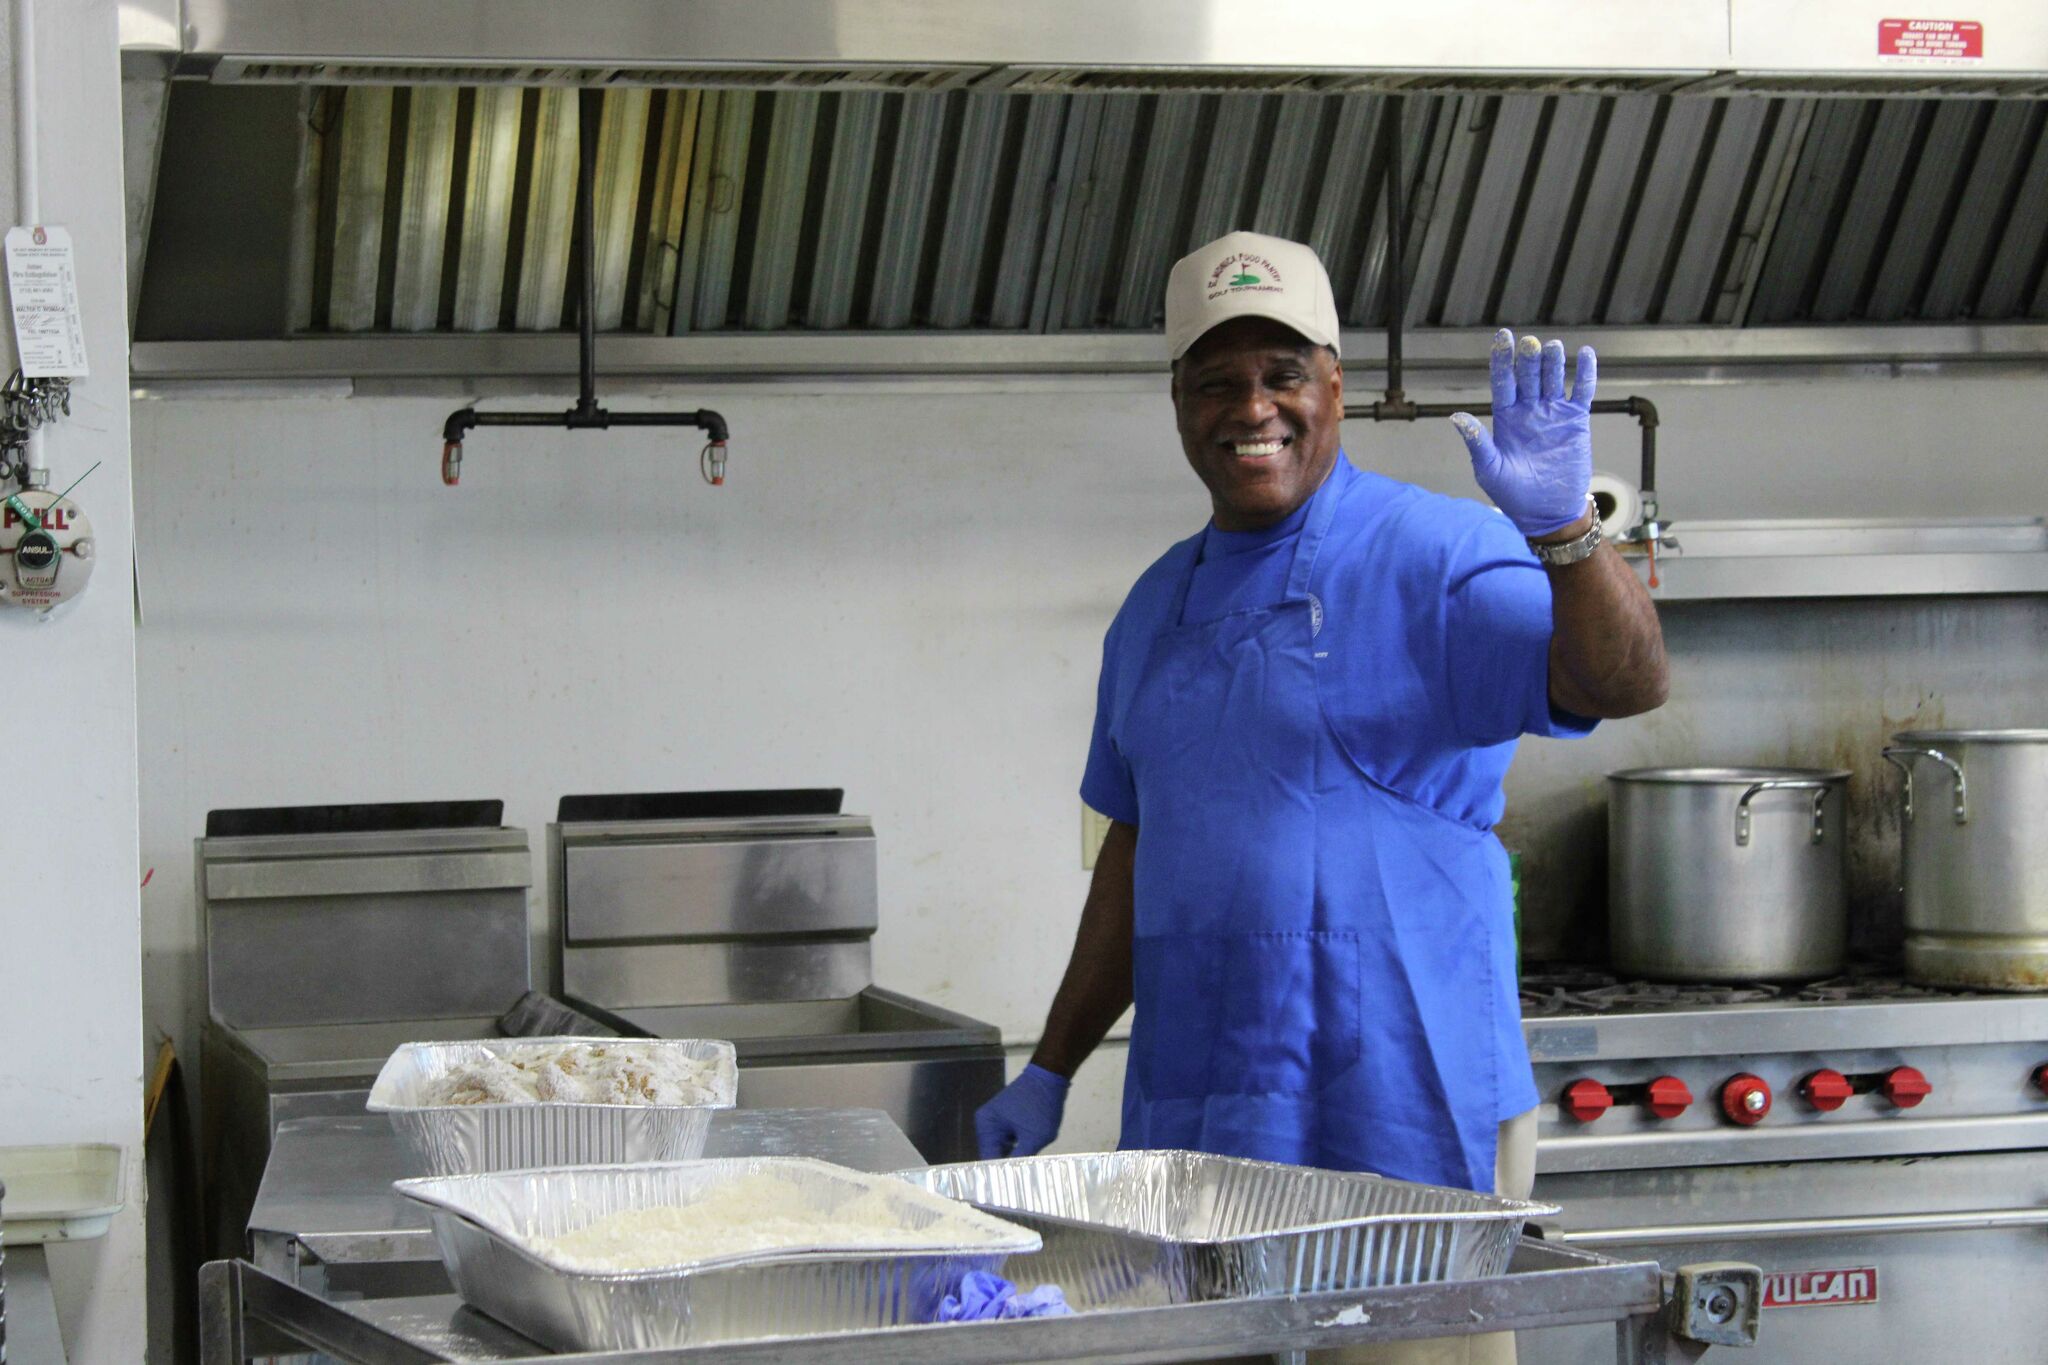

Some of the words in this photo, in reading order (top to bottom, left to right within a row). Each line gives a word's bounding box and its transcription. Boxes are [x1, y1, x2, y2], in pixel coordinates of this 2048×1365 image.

[1908, 21, 1953, 31] CAUTION
[1239, 253, 1261, 263] FOOD
[22, 546, 49, 554] ANSUL
